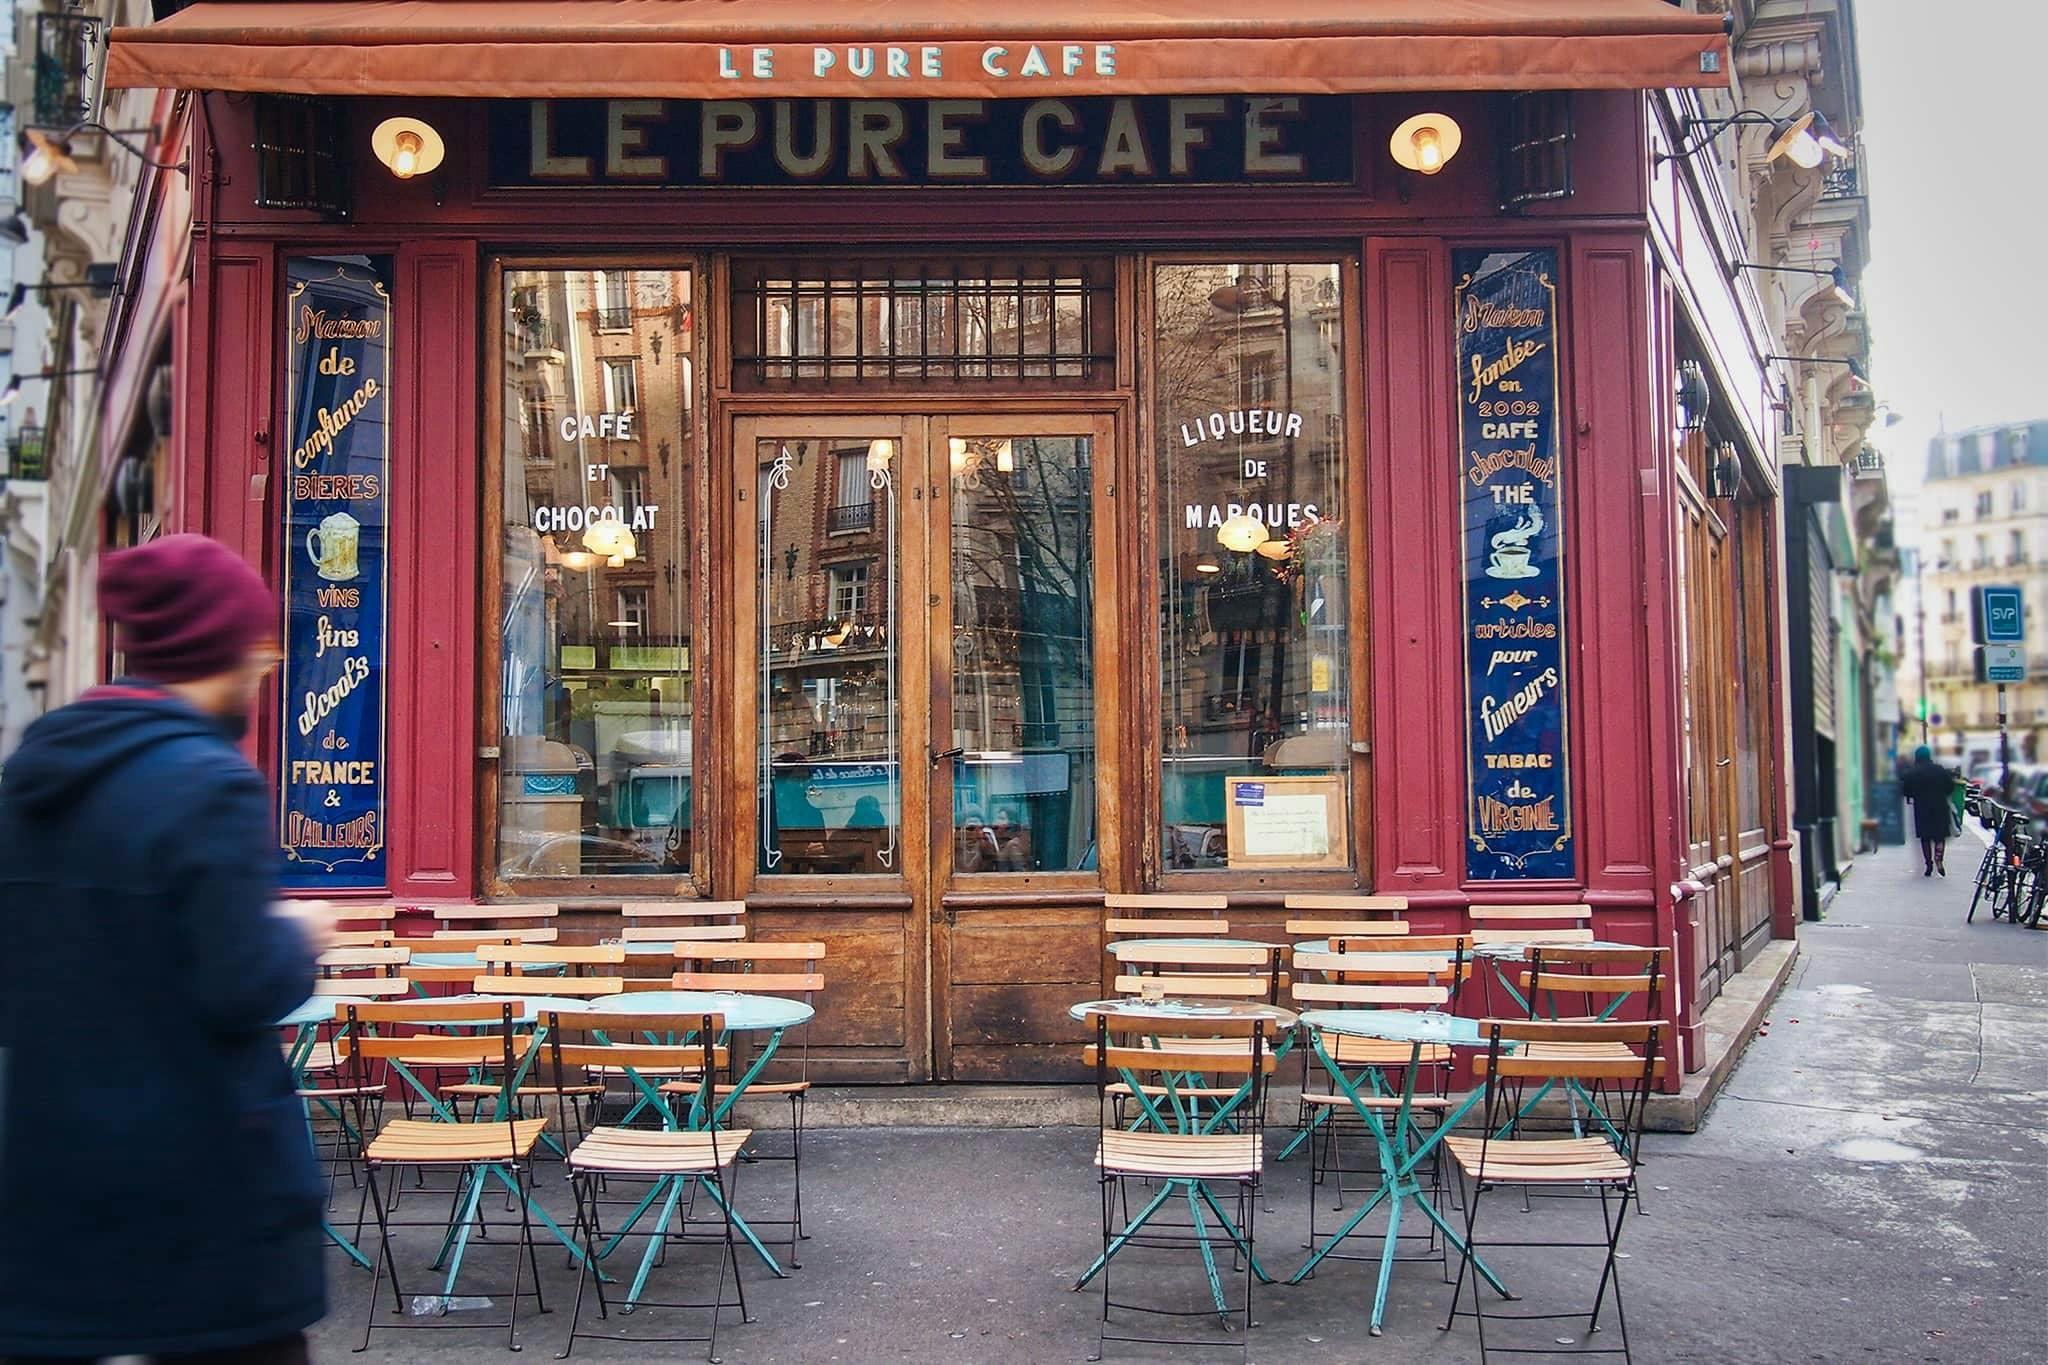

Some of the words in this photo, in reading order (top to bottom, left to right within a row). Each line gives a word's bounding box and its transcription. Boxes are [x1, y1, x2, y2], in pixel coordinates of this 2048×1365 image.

[719, 48, 773, 78] LE
[814, 47, 942, 78] PURE
[982, 44, 1116, 77] CAFE
[530, 100, 667, 177] LE
[701, 100, 988, 177] PURE
[296, 304, 381, 345] Maison
[1463, 293, 1545, 333] Maison
[319, 346, 356, 376] de
[1468, 335, 1546, 405] fondée
[1498, 380, 1523, 393] en
[1478, 400, 1540, 417] 2002
[294, 377, 381, 469] confiance
[1180, 409, 1303, 448] LIQUEUR
[1481, 419, 1539, 440] CAFÉ
[587, 464, 609, 482] ET
[1244, 459, 1267, 478] DE
[1468, 442, 1554, 489] chocolat
[1490, 481, 1535, 505] THÉ
[535, 505, 659, 532] CHOCOLAT
[1992, 607, 2016, 620] SVP
[315, 615, 360, 658] fins
[1475, 617, 1557, 640] articles
[1486, 649, 1538, 677] pour
[297, 655, 370, 737] alcools
[1479, 666, 1559, 743] fumeurs
[321, 729, 350, 751] de
[291, 761, 375, 786] FRANCE
[1484, 753, 1553, 770] TABAC
[323, 789, 342, 808] &
[1507, 779, 1537, 799] de
[1477, 794, 1560, 832] VIRGINIE
[289, 810, 376, 848] D'AILLEURS
